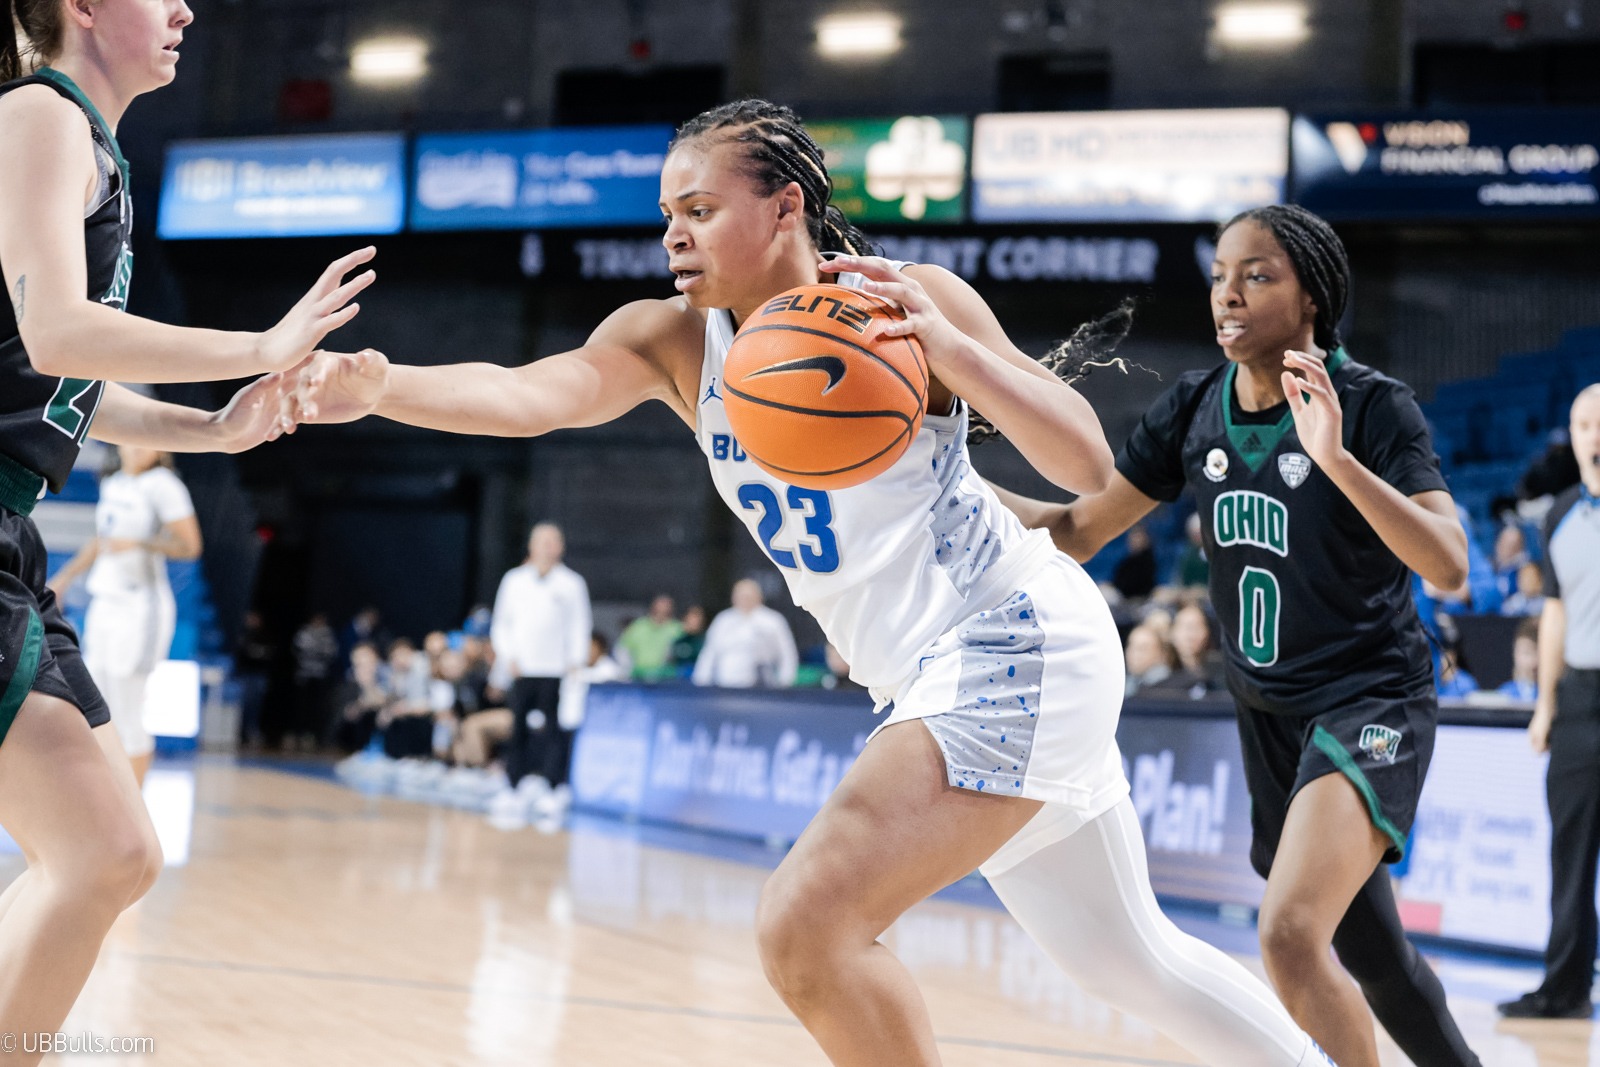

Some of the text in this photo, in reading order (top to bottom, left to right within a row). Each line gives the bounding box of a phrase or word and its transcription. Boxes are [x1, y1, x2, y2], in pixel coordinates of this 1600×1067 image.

[1509, 144, 1599, 174] GROUP
[987, 236, 1158, 281] CORNER
[761, 294, 874, 335] ELITE
[736, 479, 843, 576] 23
[1214, 490, 1288, 557] OHIO
[1238, 565, 1281, 667] 0
[1132, 749, 1230, 856] Plan!
